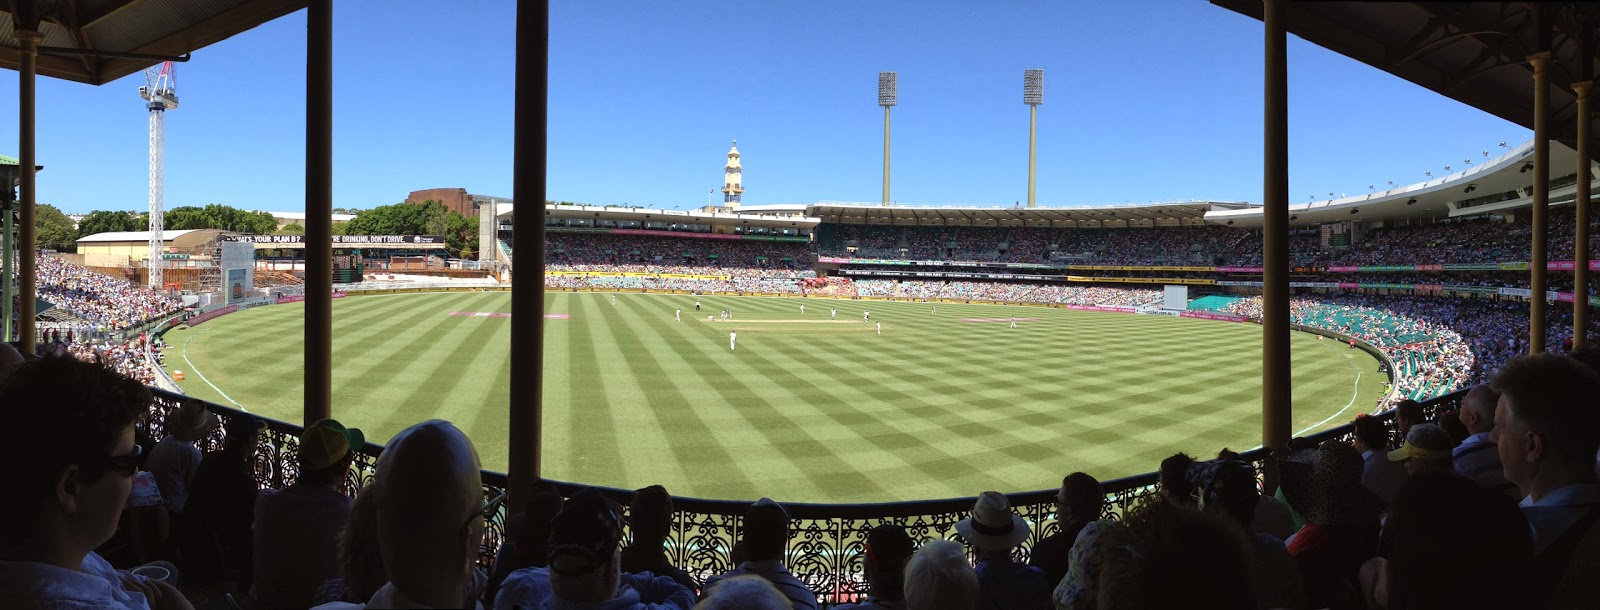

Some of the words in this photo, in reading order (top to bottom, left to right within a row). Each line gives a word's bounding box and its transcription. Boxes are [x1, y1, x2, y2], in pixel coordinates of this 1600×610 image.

[254, 235, 271, 243] YOUR
[274, 235, 290, 243] PLAN
[291, 235, 301, 243] B?
[342, 235, 370, 243] DRINKING,
[371, 235, 388, 243] DON'T
[388, 235, 405, 243] DRIVE.
